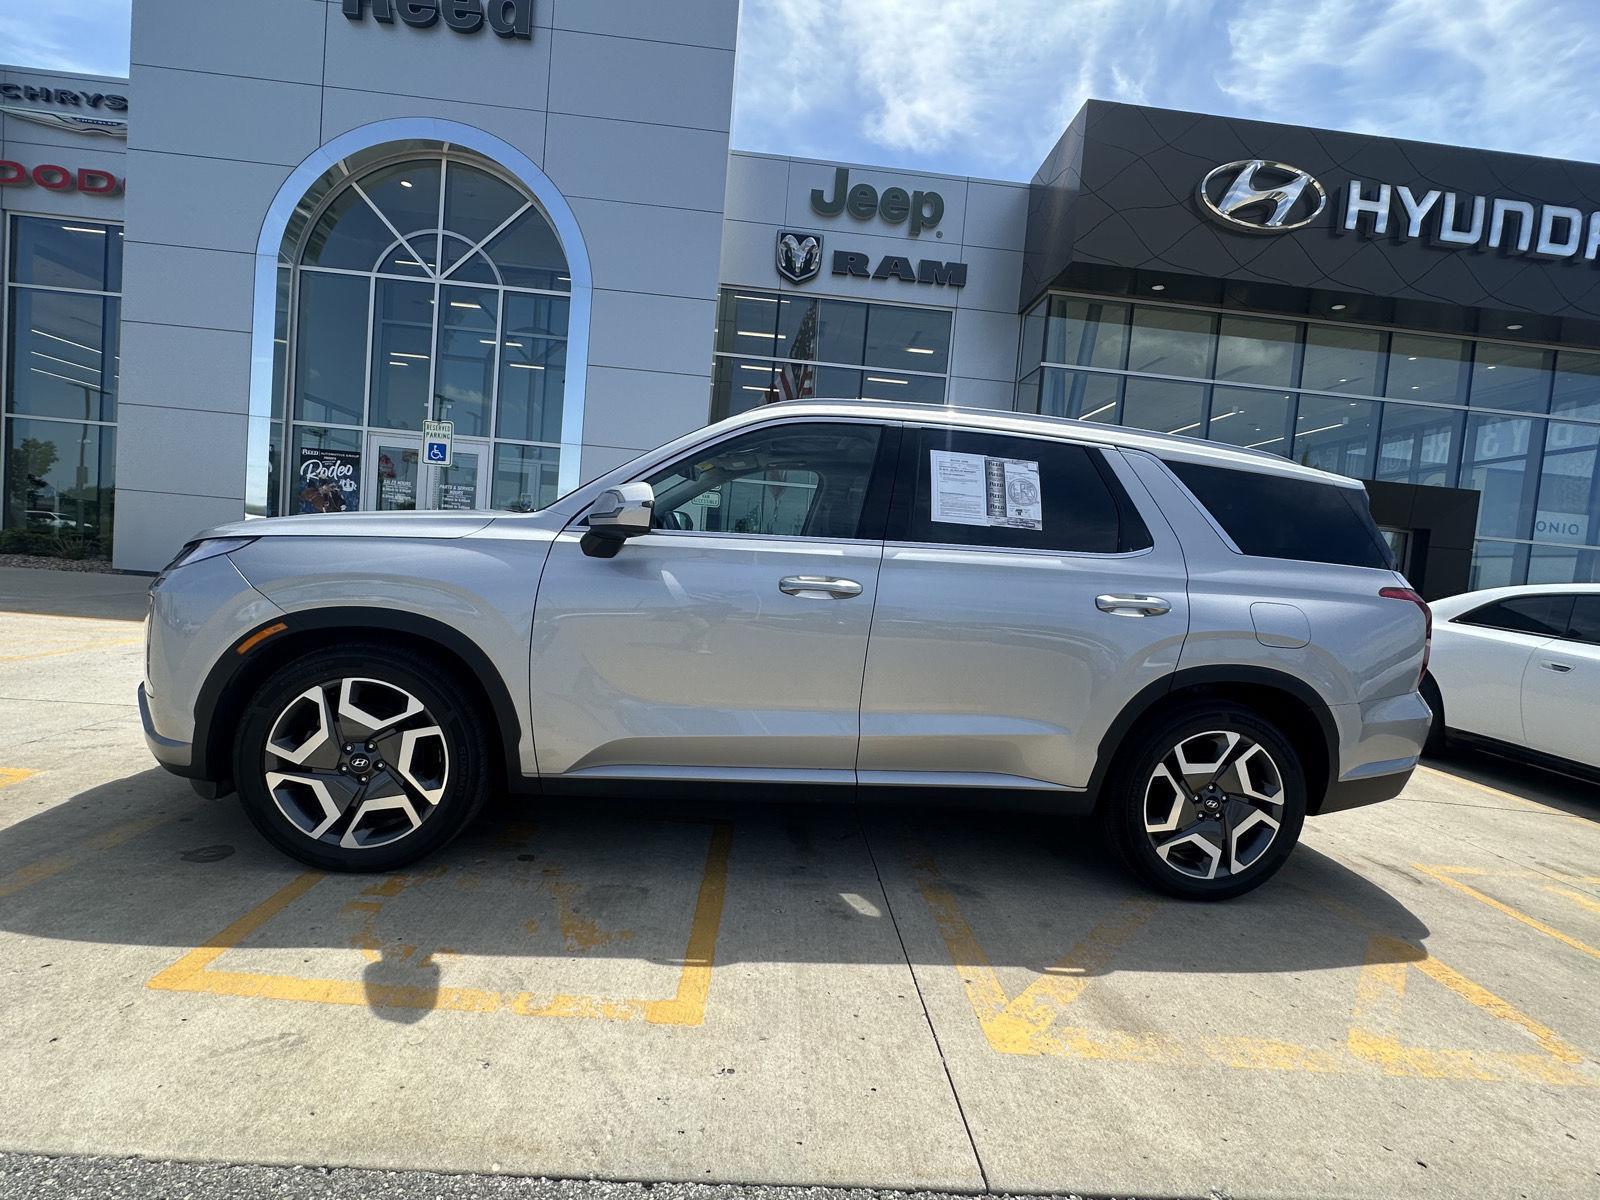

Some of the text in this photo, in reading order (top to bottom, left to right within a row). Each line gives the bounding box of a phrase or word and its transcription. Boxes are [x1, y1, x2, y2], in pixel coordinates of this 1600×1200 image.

[343, 0, 531, 40] eed
[0, 160, 125, 193] DOD
[811, 167, 945, 239] Jeep
[832, 250, 968, 288] RAM
[426, 423, 451, 432] RESERVED
[426, 431, 451, 440] PARKING
[300, 459, 353, 483] Rodeo
[1535, 520, 1580, 536] ONIQ
